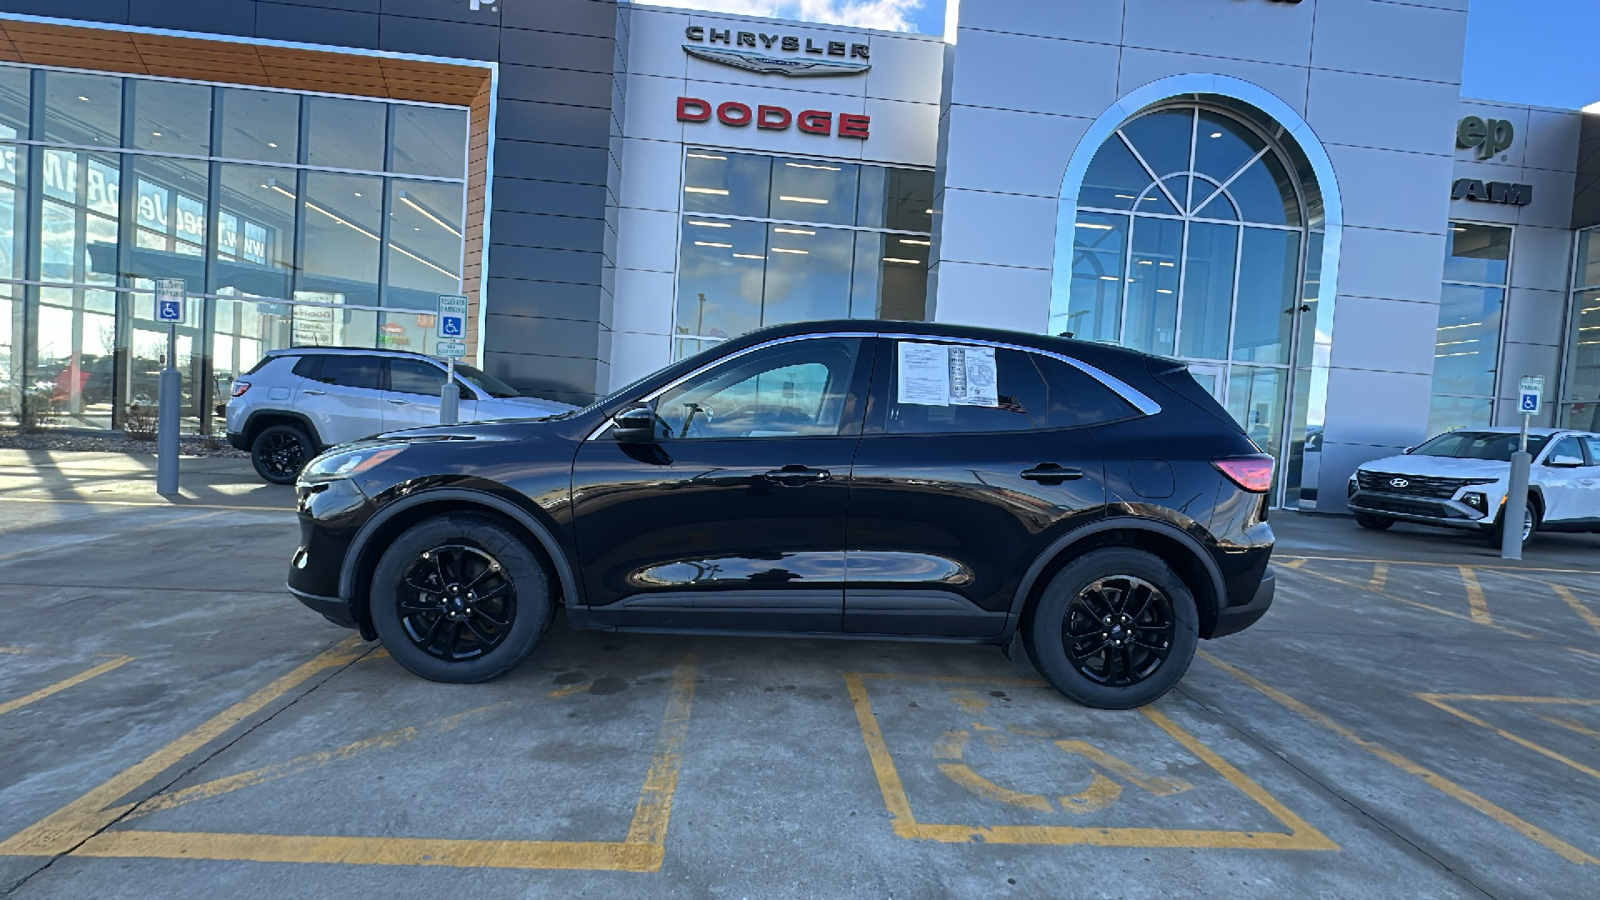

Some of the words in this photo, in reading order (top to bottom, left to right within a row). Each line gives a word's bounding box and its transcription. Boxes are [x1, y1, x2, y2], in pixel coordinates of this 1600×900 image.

[685, 25, 870, 59] CHRYSLER
[676, 96, 870, 140] DODGE
[1455, 115, 1514, 160] ep
[1451, 178, 1533, 206] AM
